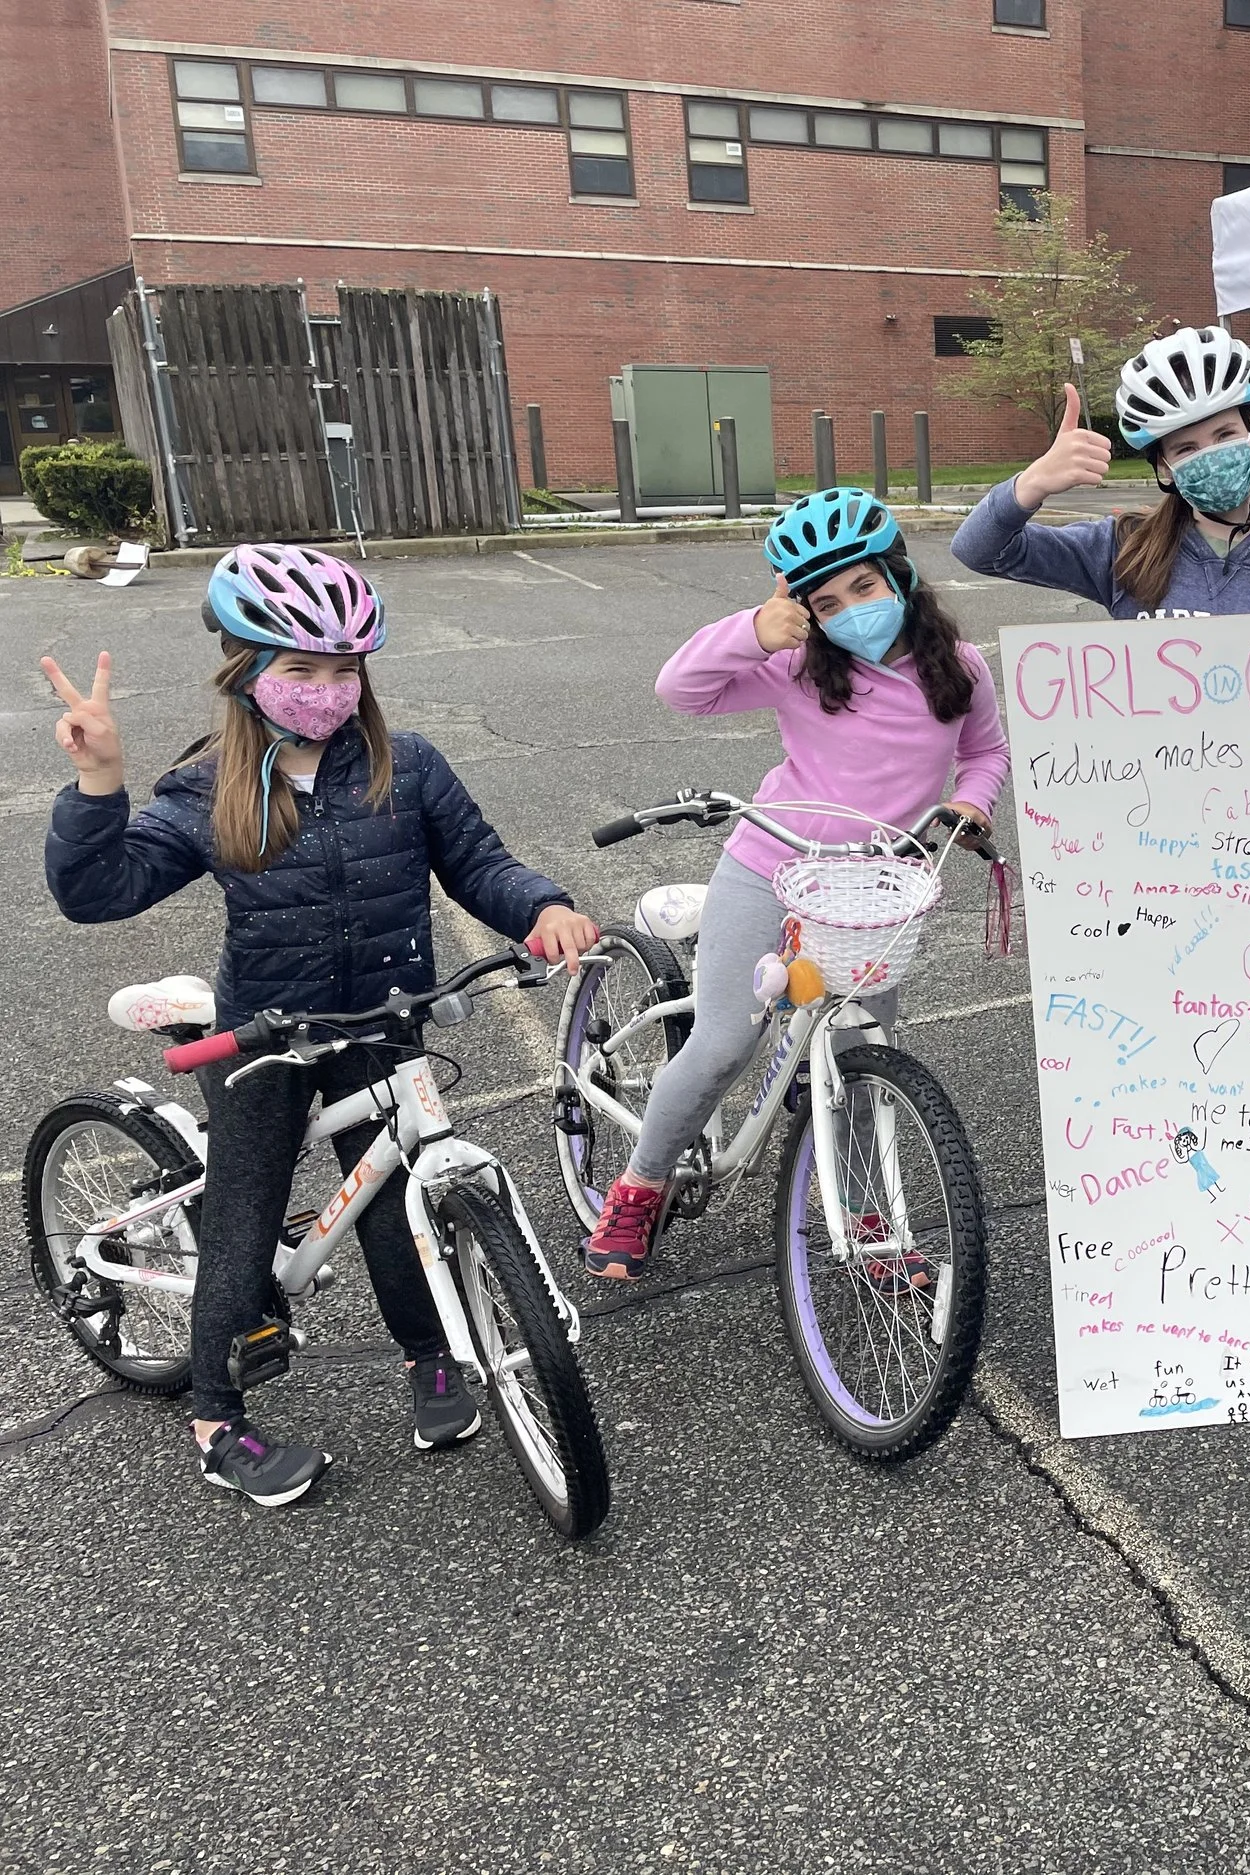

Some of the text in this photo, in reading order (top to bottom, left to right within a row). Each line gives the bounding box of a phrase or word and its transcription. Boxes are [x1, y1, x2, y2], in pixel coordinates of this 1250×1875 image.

[1016, 639, 1202, 720] GIRLS
[1213, 675, 1237, 694] IN
[1030, 742, 1151, 827] riding
[1155, 731, 1243, 771] makes
[1136, 906, 1176, 929] Happy
[1112, 1075, 1167, 1097] makes
[1178, 1081, 1198, 1093] me
[1208, 1081, 1244, 1096] want
[1081, 1158, 1169, 1205] Dance
[1058, 1233, 1113, 1264] Free
[1079, 1318, 1124, 1338] makes
[1136, 1323, 1155, 1333] me
[1199, 1330, 1211, 1344] to
[1154, 1360, 1184, 1378] fun
[1223, 1356, 1242, 1371] It
[1225, 1378, 1246, 1388] us
